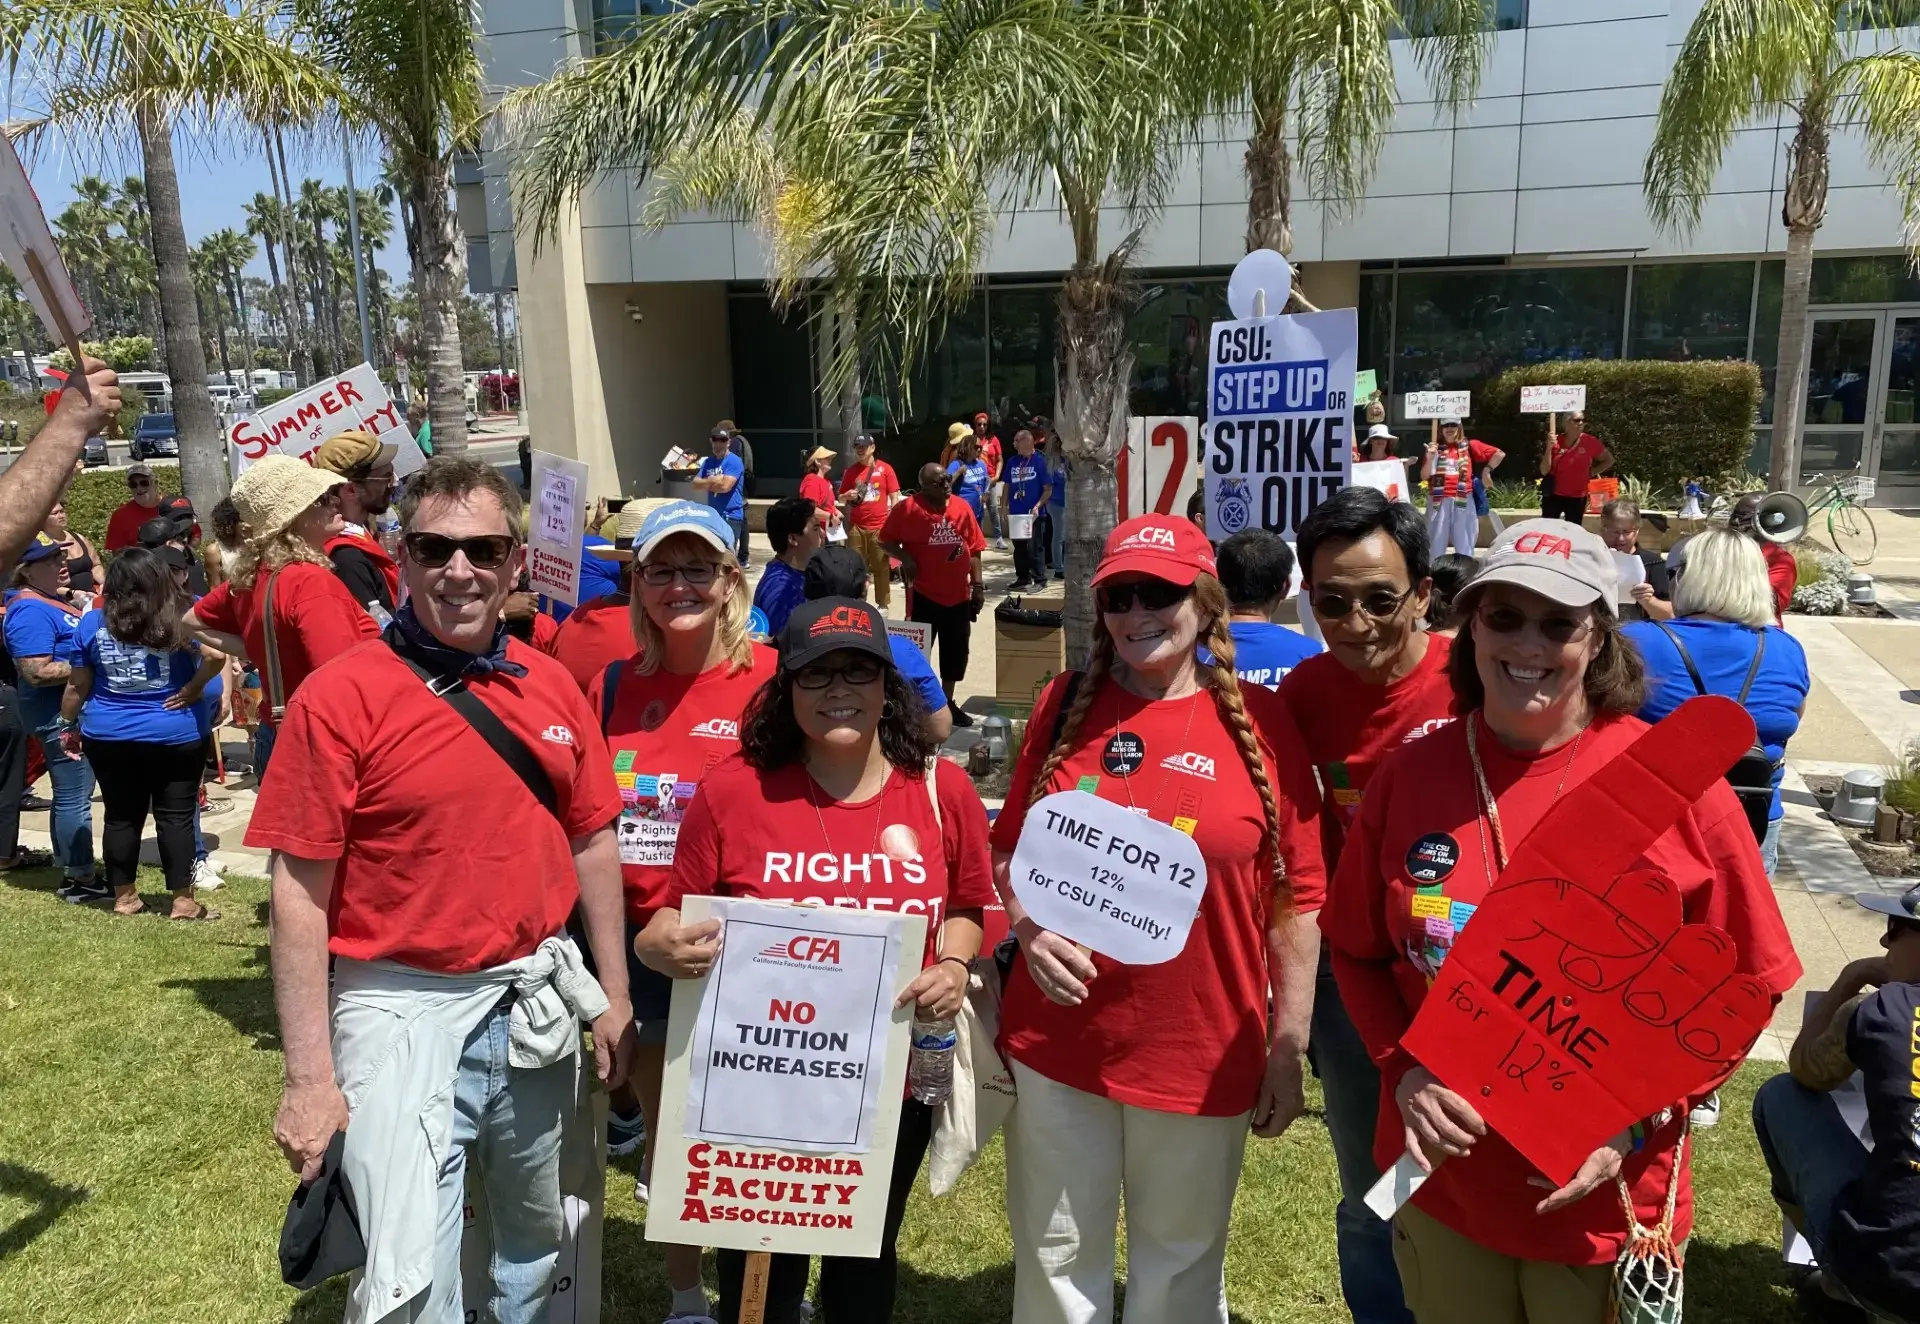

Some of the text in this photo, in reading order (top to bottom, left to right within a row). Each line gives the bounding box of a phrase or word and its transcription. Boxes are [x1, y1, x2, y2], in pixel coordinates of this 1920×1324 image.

[1217, 326, 1272, 364] CSU:
[1217, 369, 1280, 412] STEP
[1286, 367, 1325, 408] UP
[1328, 391, 1346, 410] OR
[232, 381, 363, 459] SUMMER
[1213, 417, 1345, 475] STRIKE
[547, 515, 566, 533] 12%
[932, 529, 957, 537] CLASS
[1138, 526, 1176, 547] CFA
[1514, 531, 1572, 560] CFA
[533, 548, 573, 570] CALIFORNIA
[533, 560, 572, 581] FACULTY
[532, 570, 571, 592] ASSOCIATION
[831, 606, 872, 631] CFA
[549, 725, 574, 742] CFA
[708, 718, 738, 737] CFA
[1422, 718, 1457, 735] CF
[1182, 752, 1215, 776] CFA
[641, 824, 676, 837] Rights
[636, 837, 676, 850] Respec
[639, 851, 673, 861] Justic
[1046, 810, 1196, 888] TIME FOR 12
[1436, 844, 1450, 852] CSU
[763, 852, 927, 883] RIGHTS
[1422, 869, 1436, 877] CFA
[1431, 855, 1455, 866] LABOR
[1091, 866, 1125, 892] 12%
[1028, 868, 1172, 941] for CSU Faculty!
[787, 936, 840, 965] CFA
[752, 957, 843, 973] California Faculty Association
[768, 999, 816, 1025] NO
[1492, 949, 1610, 1069] TIME
[736, 1023, 849, 1052] TUITION
[1447, 980, 1577, 1093] for 12%
[712, 1051, 864, 1080] INCREASES!
[982, 1083, 1017, 1097] Cultivatin
[687, 1142, 863, 1176] CALIFORNIA
[685, 1171, 859, 1205] FACULTY
[680, 1198, 853, 1229] ASSOCIATION
